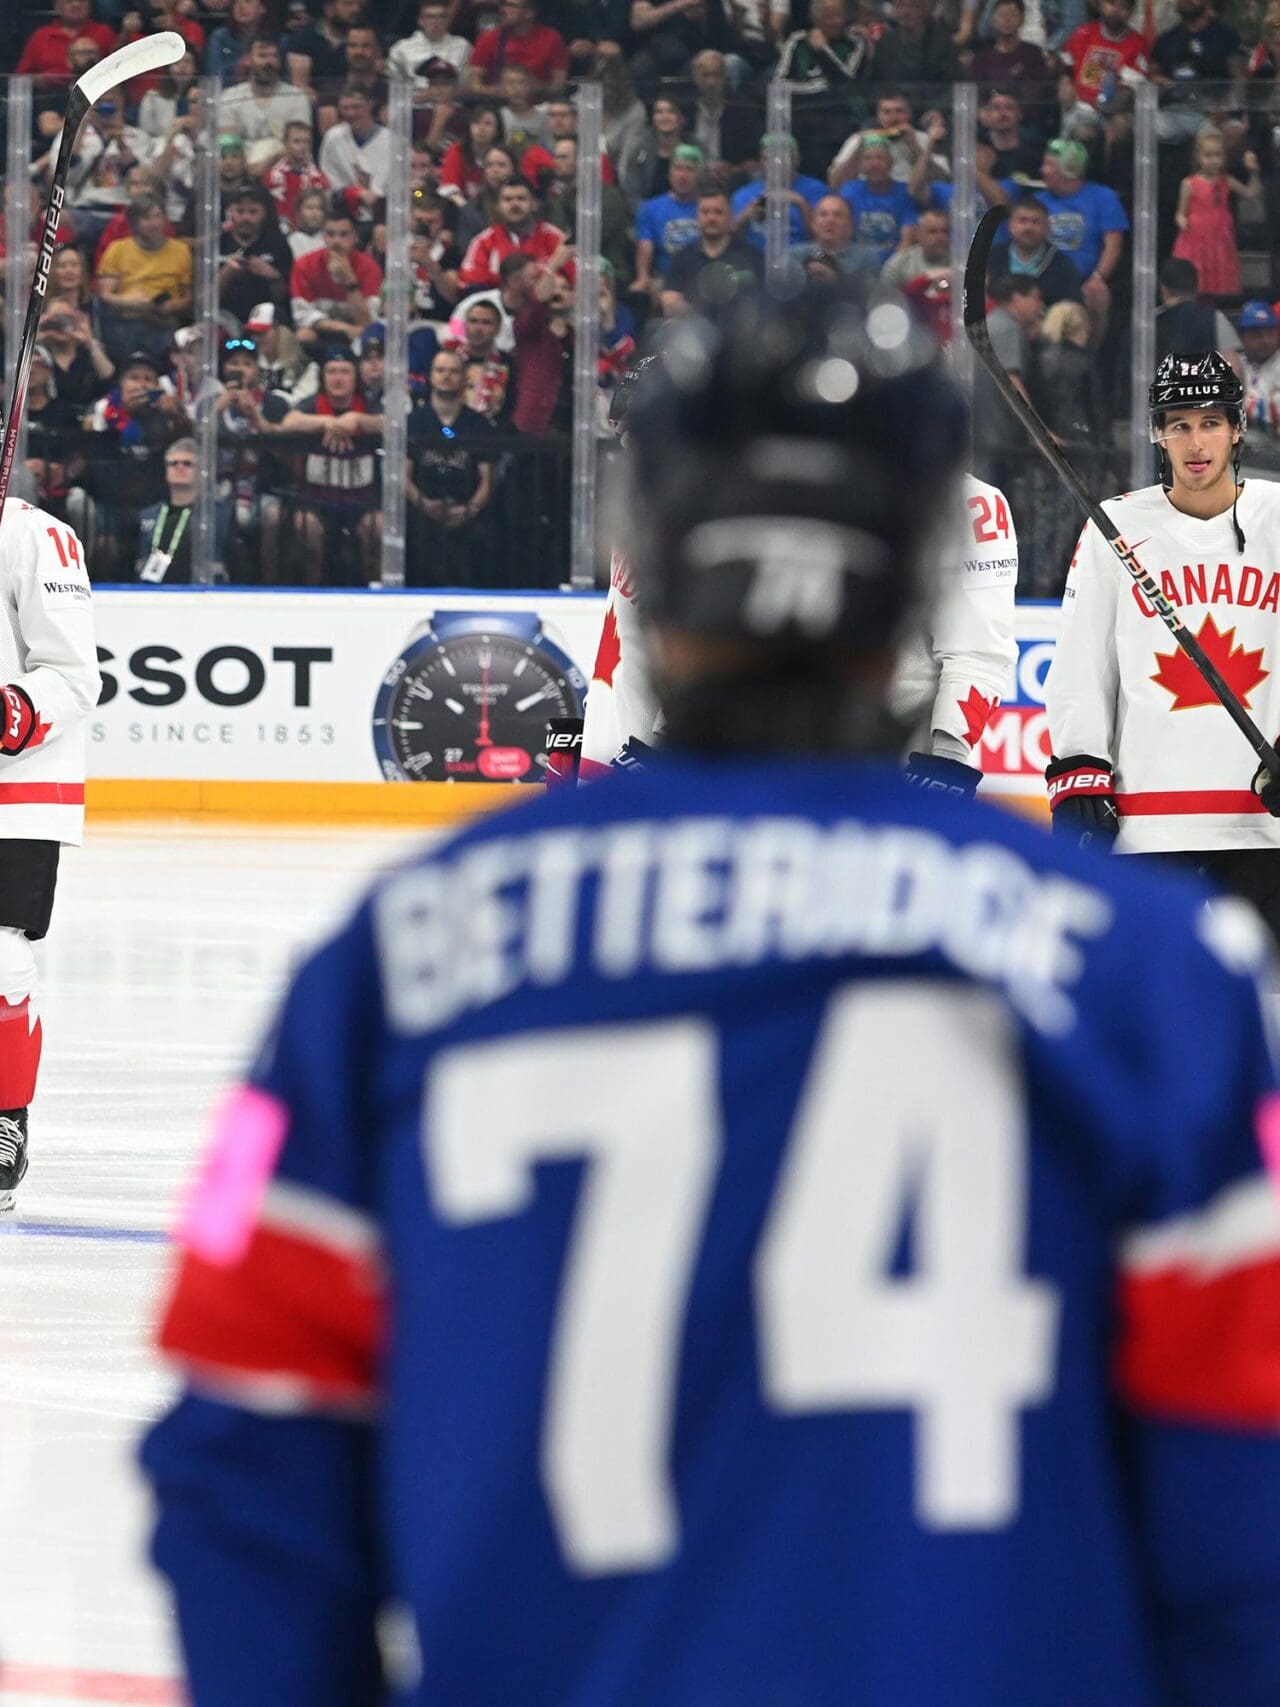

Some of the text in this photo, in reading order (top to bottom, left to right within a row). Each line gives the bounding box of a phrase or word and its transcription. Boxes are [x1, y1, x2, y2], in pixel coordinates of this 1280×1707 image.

[1178, 384, 1221, 397] TELUS
[966, 494, 1009, 544] 24
[46, 526, 80, 570] 14
[128, 722, 233, 743] SINCE
[257, 722, 335, 743] 1853
[420, 978, 1060, 1576] 74
